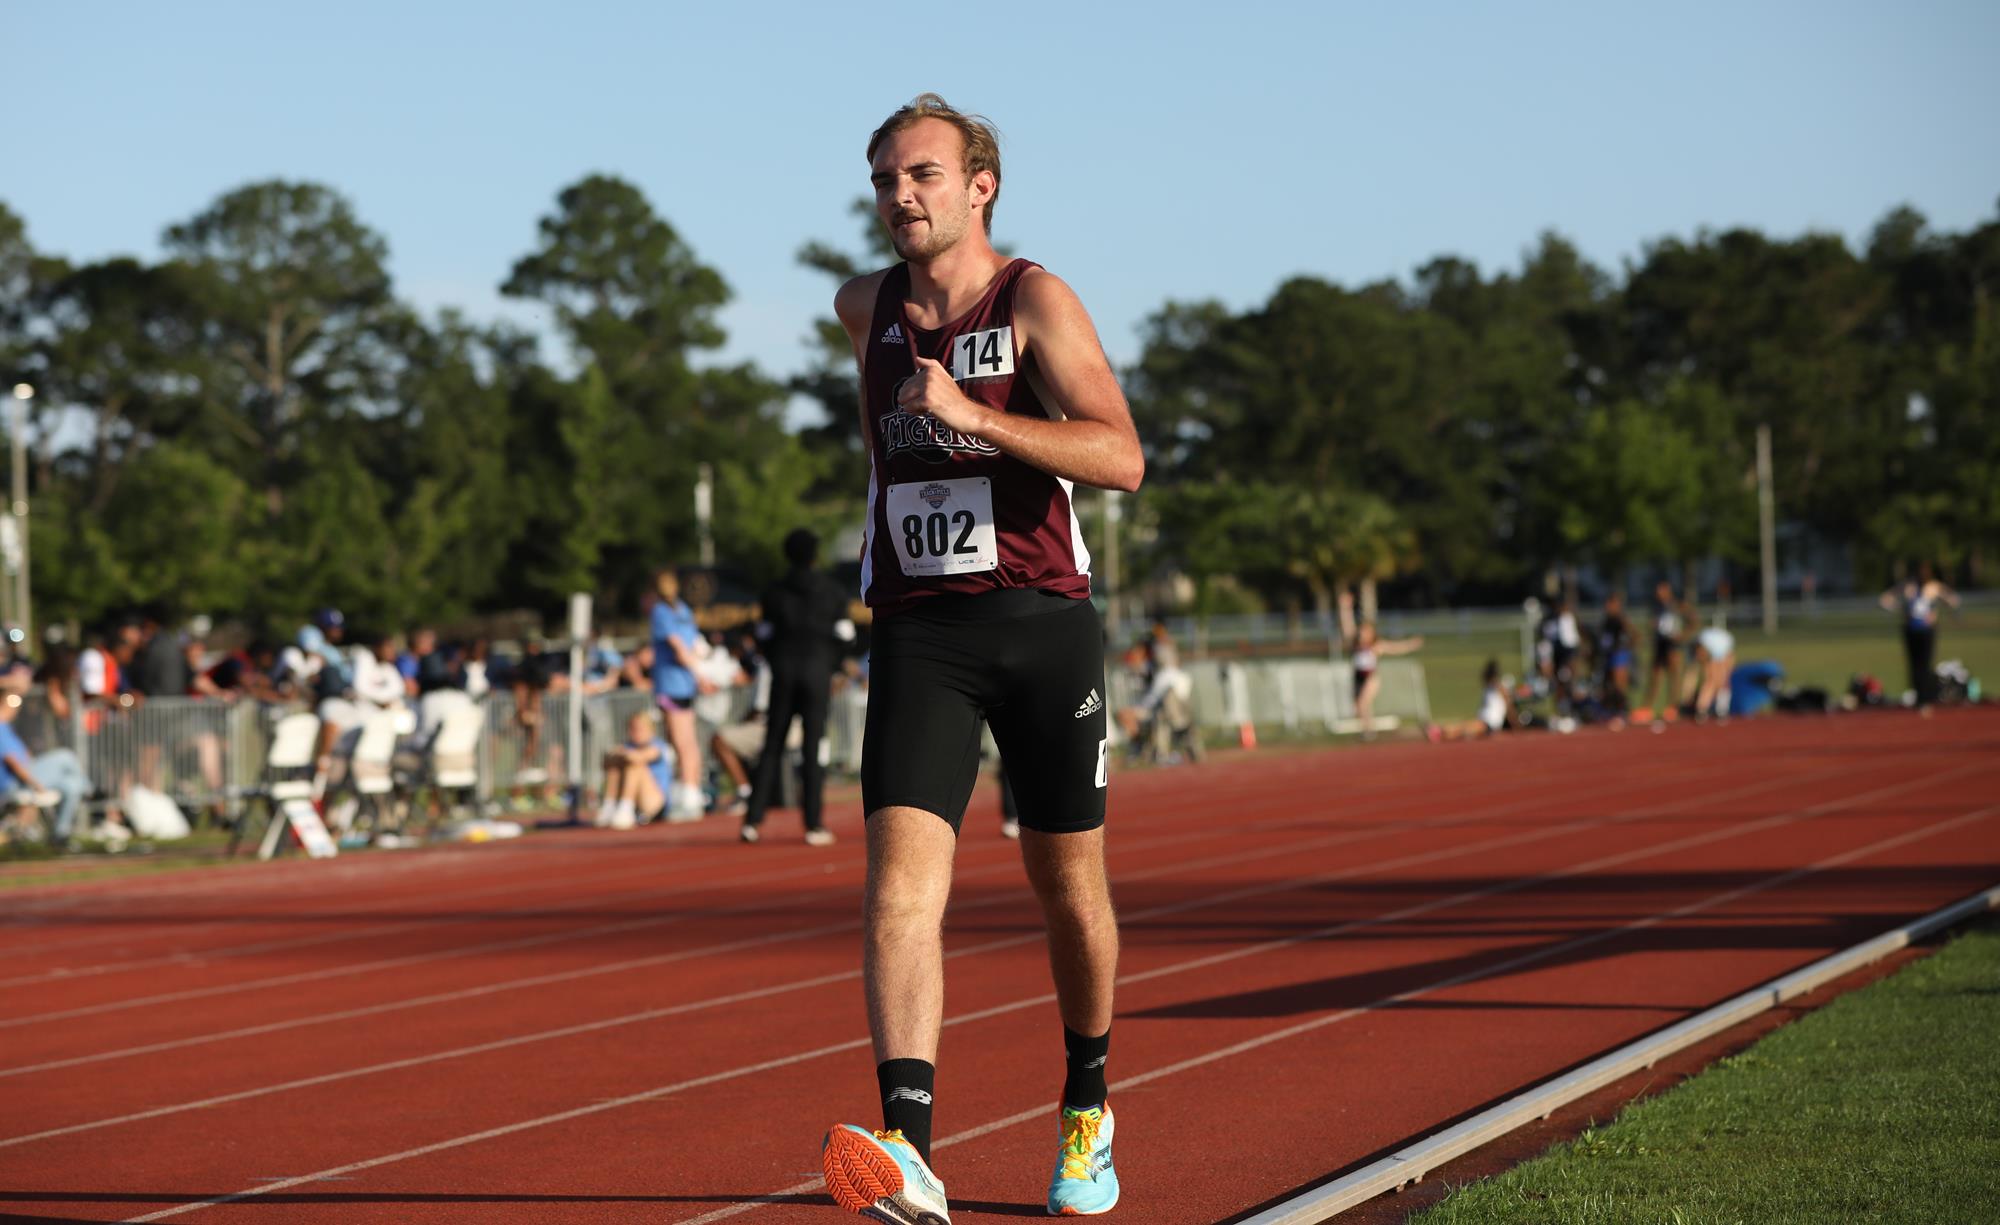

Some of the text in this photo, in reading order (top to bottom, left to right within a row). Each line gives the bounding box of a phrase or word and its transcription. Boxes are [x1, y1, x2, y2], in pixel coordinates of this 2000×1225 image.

[881, 335, 904, 344] adidas
[962, 331, 1003, 375] 14
[902, 510, 978, 558] 802
